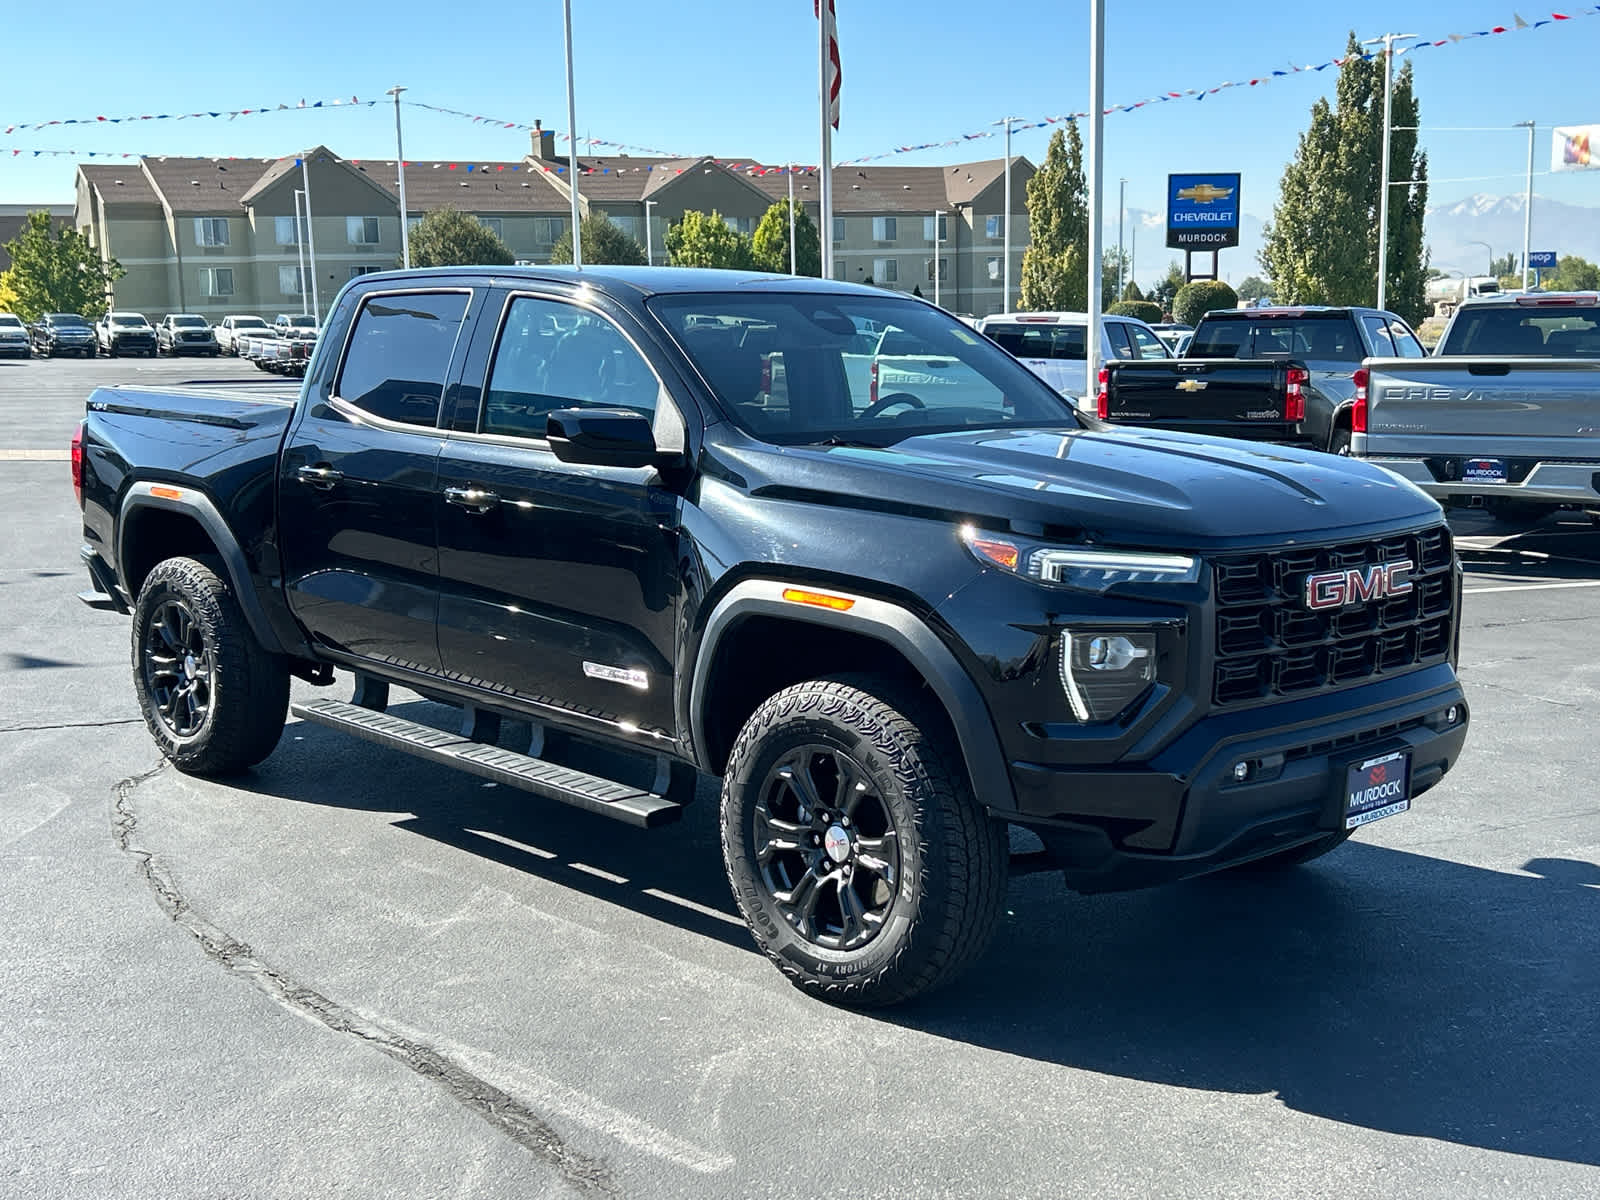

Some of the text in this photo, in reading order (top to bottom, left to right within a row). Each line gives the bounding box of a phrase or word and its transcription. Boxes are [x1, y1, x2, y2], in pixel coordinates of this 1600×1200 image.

[1174, 212, 1233, 222] CHEVROLET
[1178, 233, 1227, 242] MURDOCK
[1530, 253, 1551, 263] HOP
[1306, 560, 1413, 610] GMC
[1350, 779, 1400, 807] MURDOCK
[1361, 807, 1395, 821] MURDOCK
